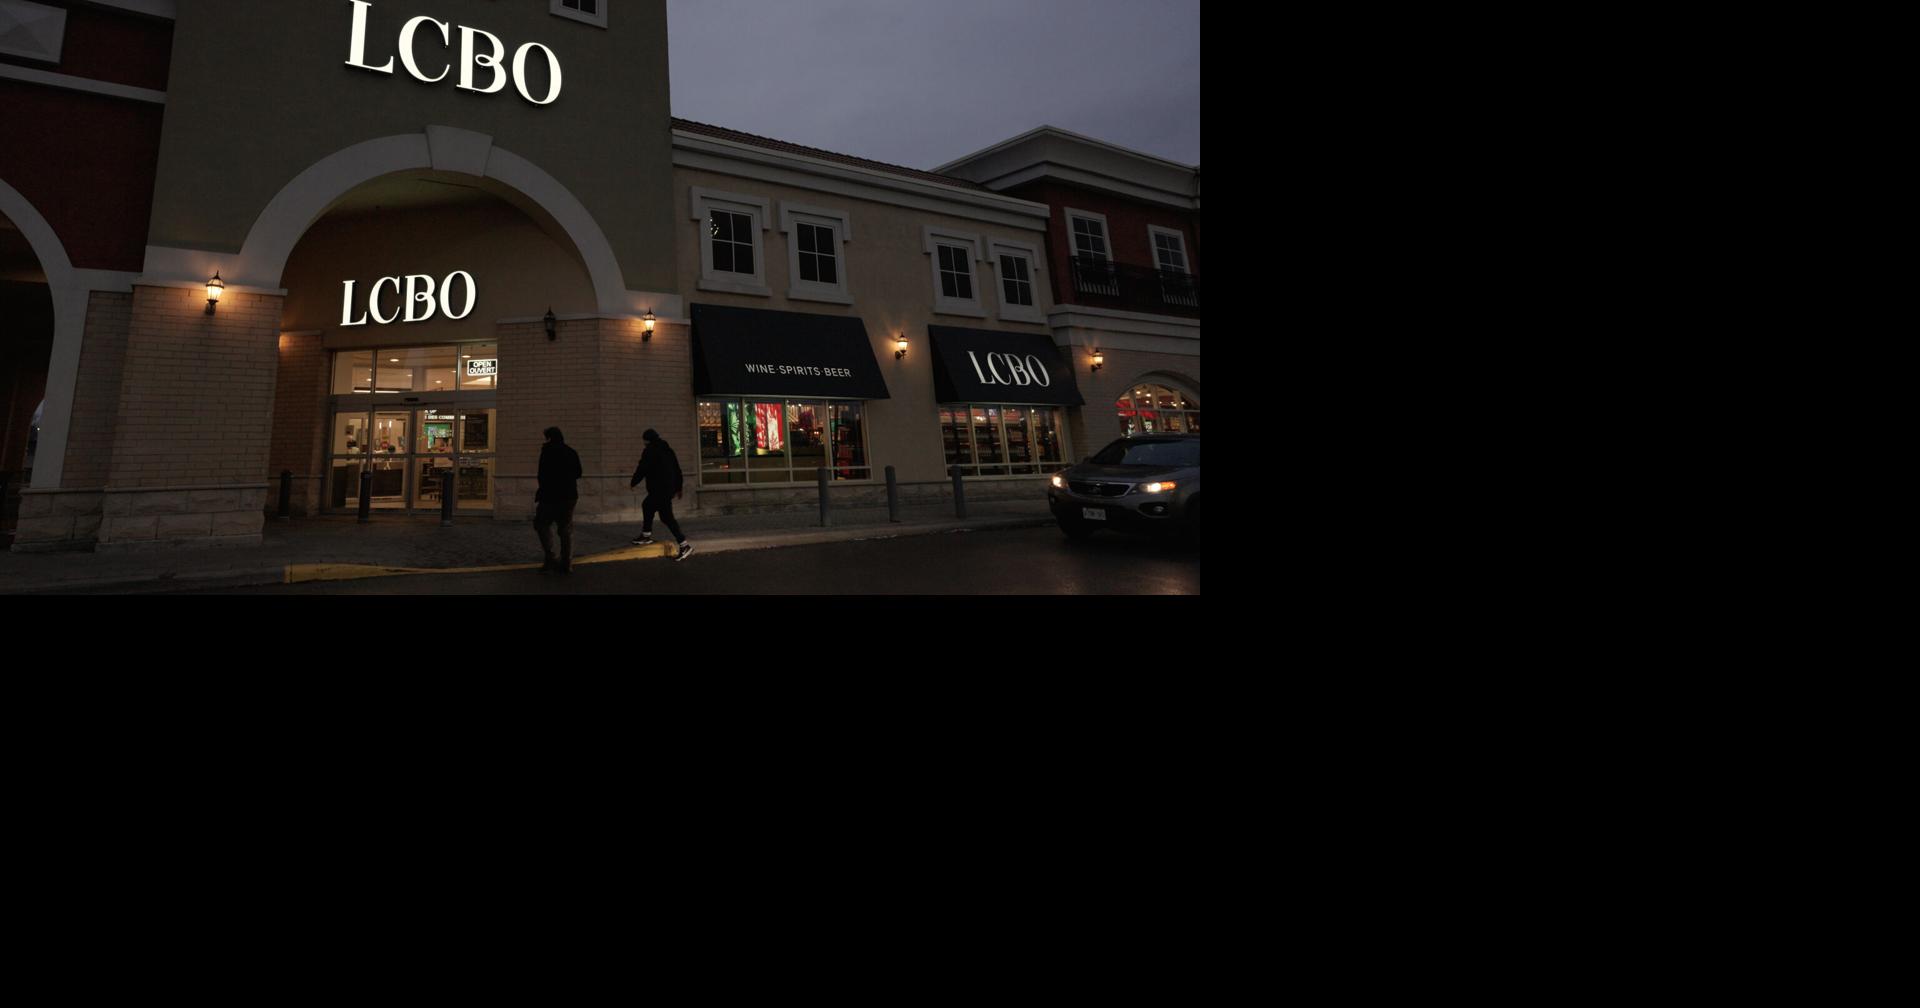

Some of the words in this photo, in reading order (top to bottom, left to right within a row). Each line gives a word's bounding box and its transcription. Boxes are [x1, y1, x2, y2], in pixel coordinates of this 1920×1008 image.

[344, 0, 562, 105] LCBO
[340, 270, 476, 326] LCBO
[470, 366, 495, 374] OUVERT
[745, 363, 776, 374] WINE
[778, 365, 821, 376] SPIRITS
[823, 367, 852, 377] BEER
[968, 351, 1051, 387] LCBO
